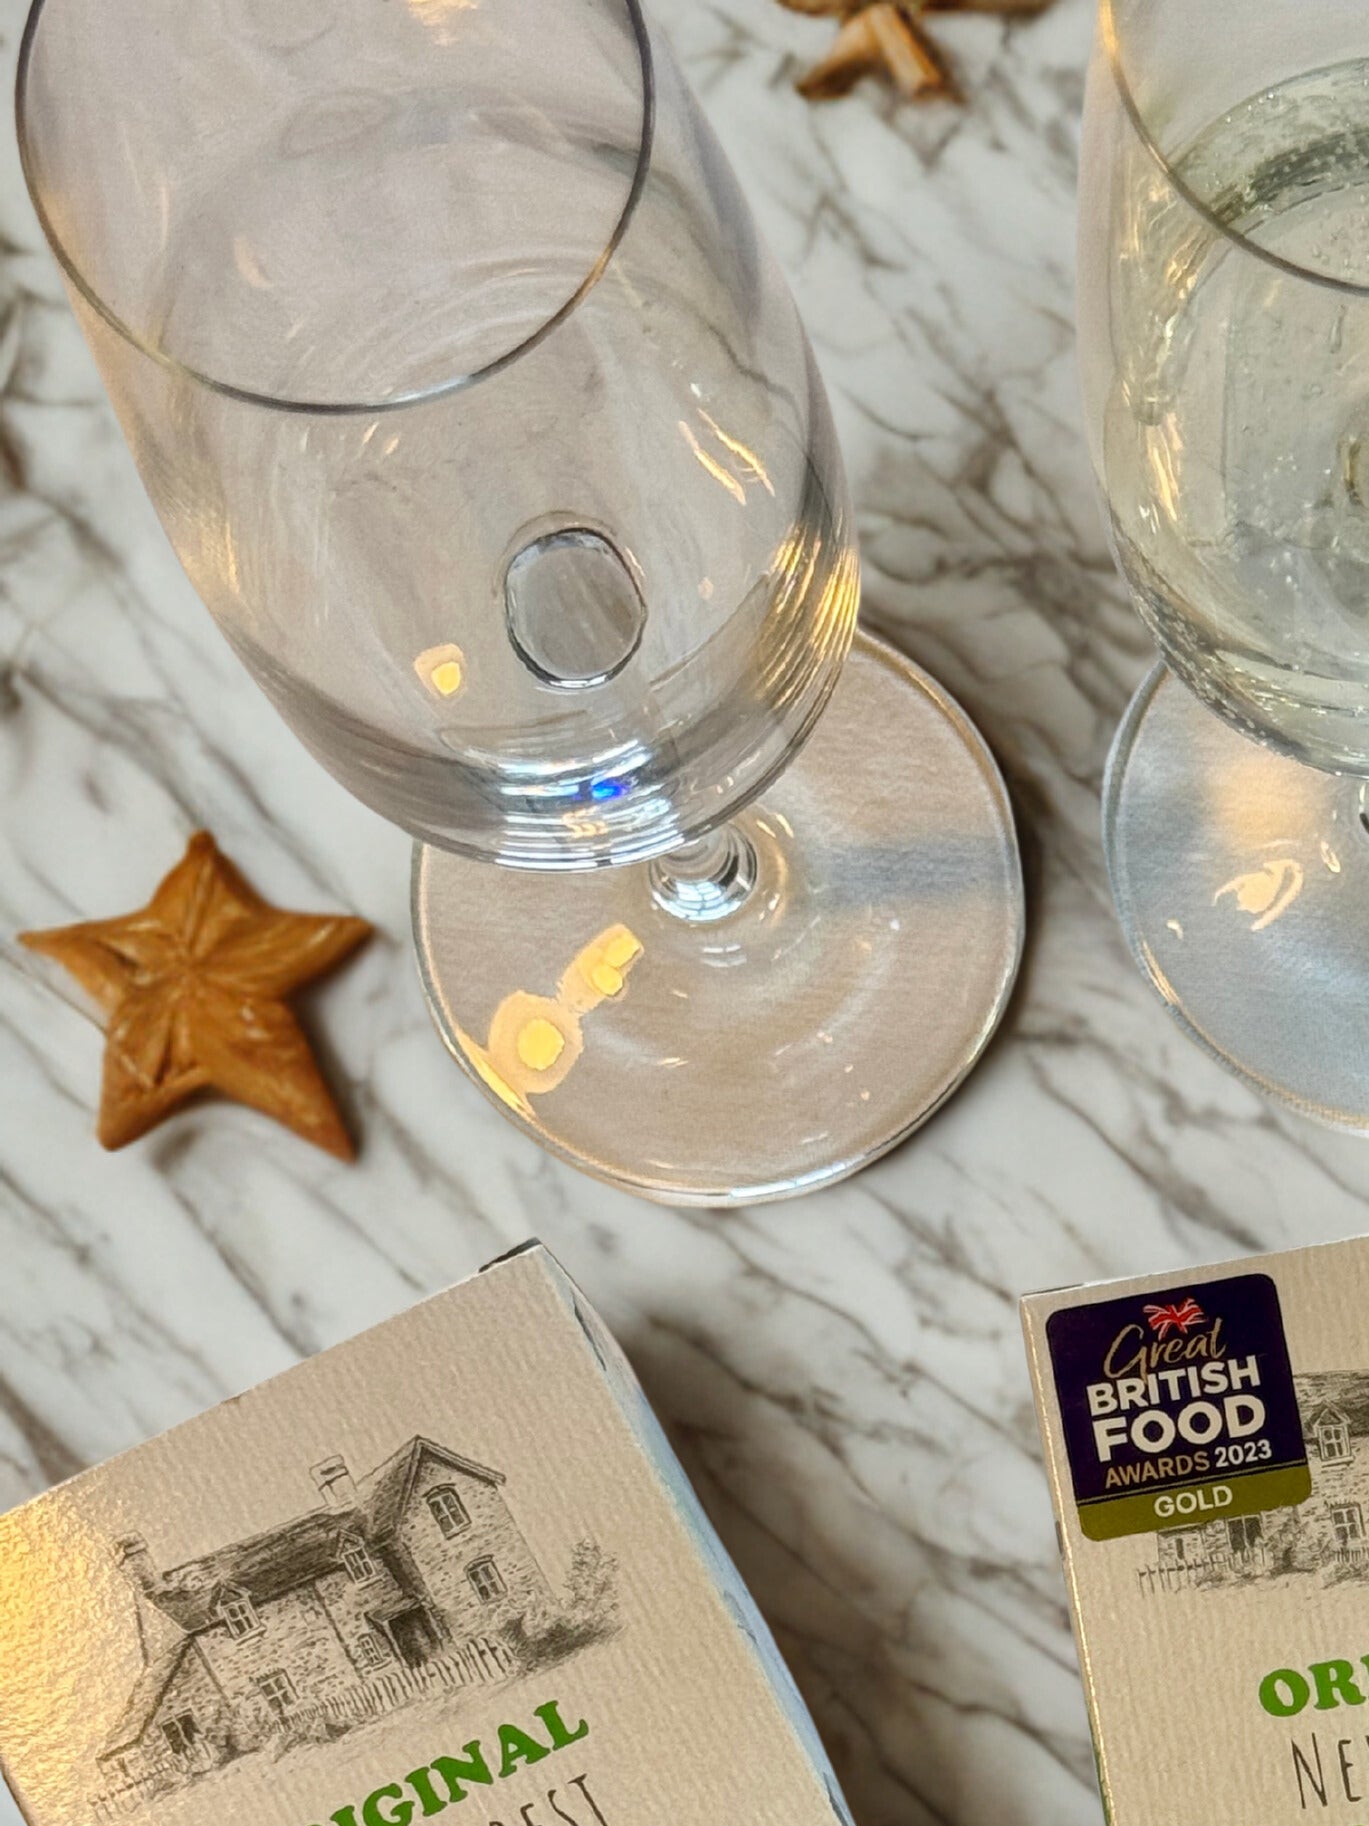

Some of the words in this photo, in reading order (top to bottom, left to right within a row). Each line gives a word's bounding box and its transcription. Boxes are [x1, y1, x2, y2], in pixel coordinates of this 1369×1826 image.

[1104, 1317, 1228, 1379] Great
[1086, 1355, 1261, 1416] BRITISH
[1091, 1395, 1266, 1462] FOOD
[1105, 1450, 1211, 1489] AWARDS
[1214, 1438, 1273, 1470] 2023
[1153, 1485, 1233, 1518] GOLD
